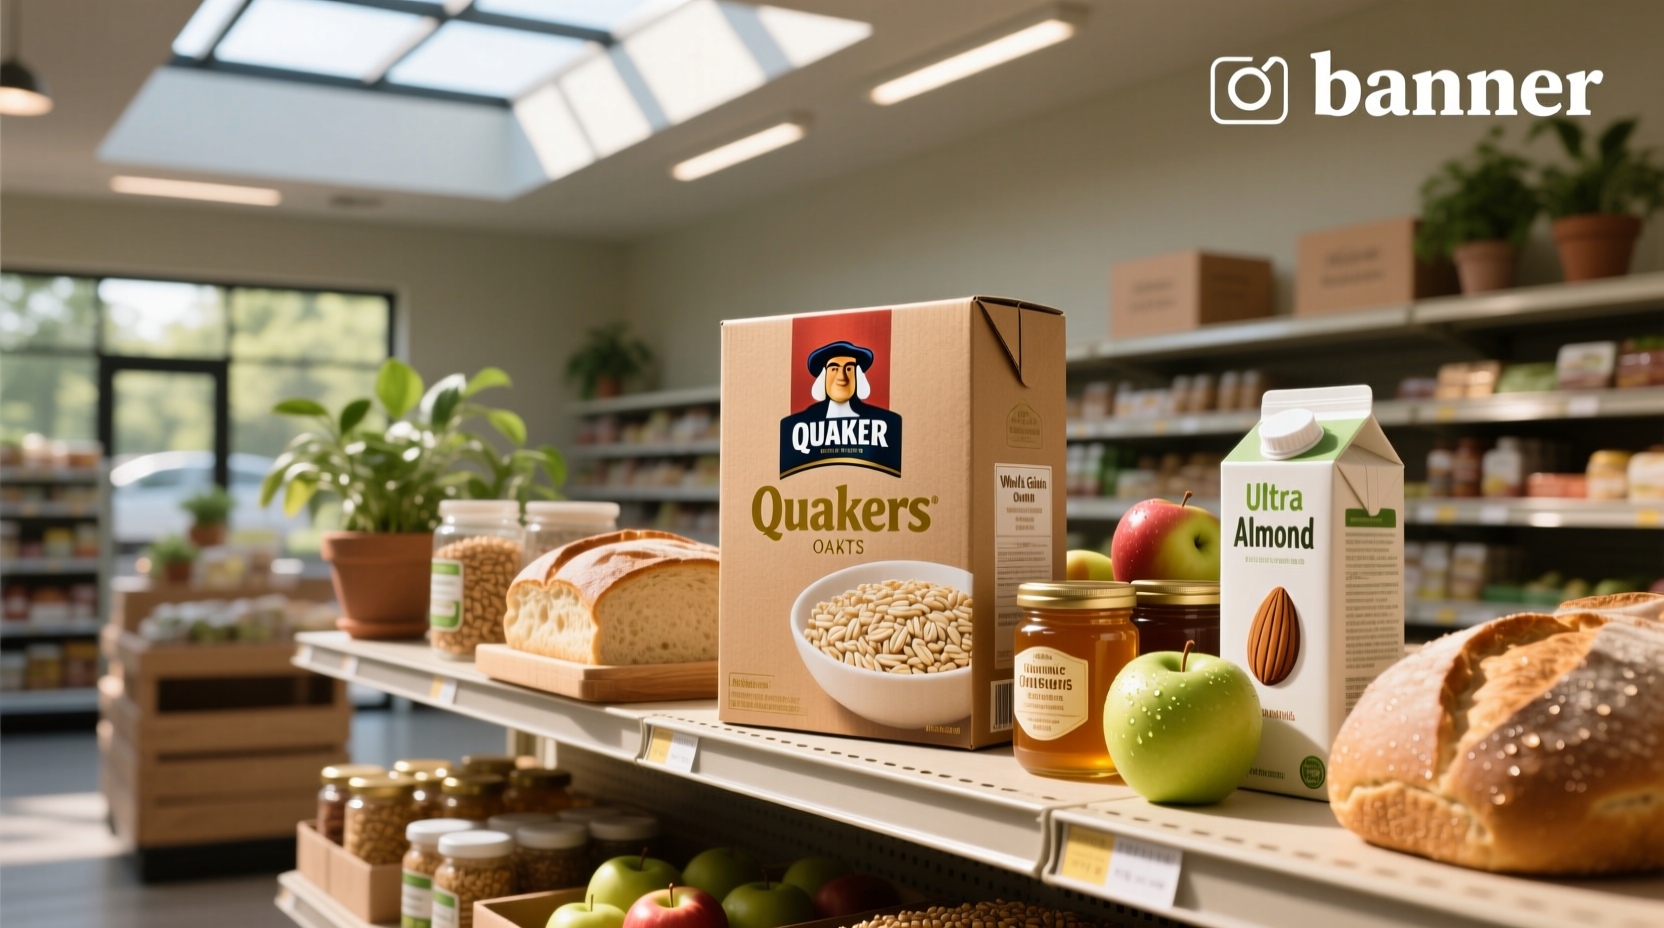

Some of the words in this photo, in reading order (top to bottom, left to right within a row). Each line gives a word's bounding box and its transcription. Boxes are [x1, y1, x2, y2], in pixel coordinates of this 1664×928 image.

[792, 419, 889, 454] QUAKER
[1246, 482, 1303, 511] Ultra
[812, 538, 864, 555] OAKTS
[1233, 516, 1315, 550] Almond
